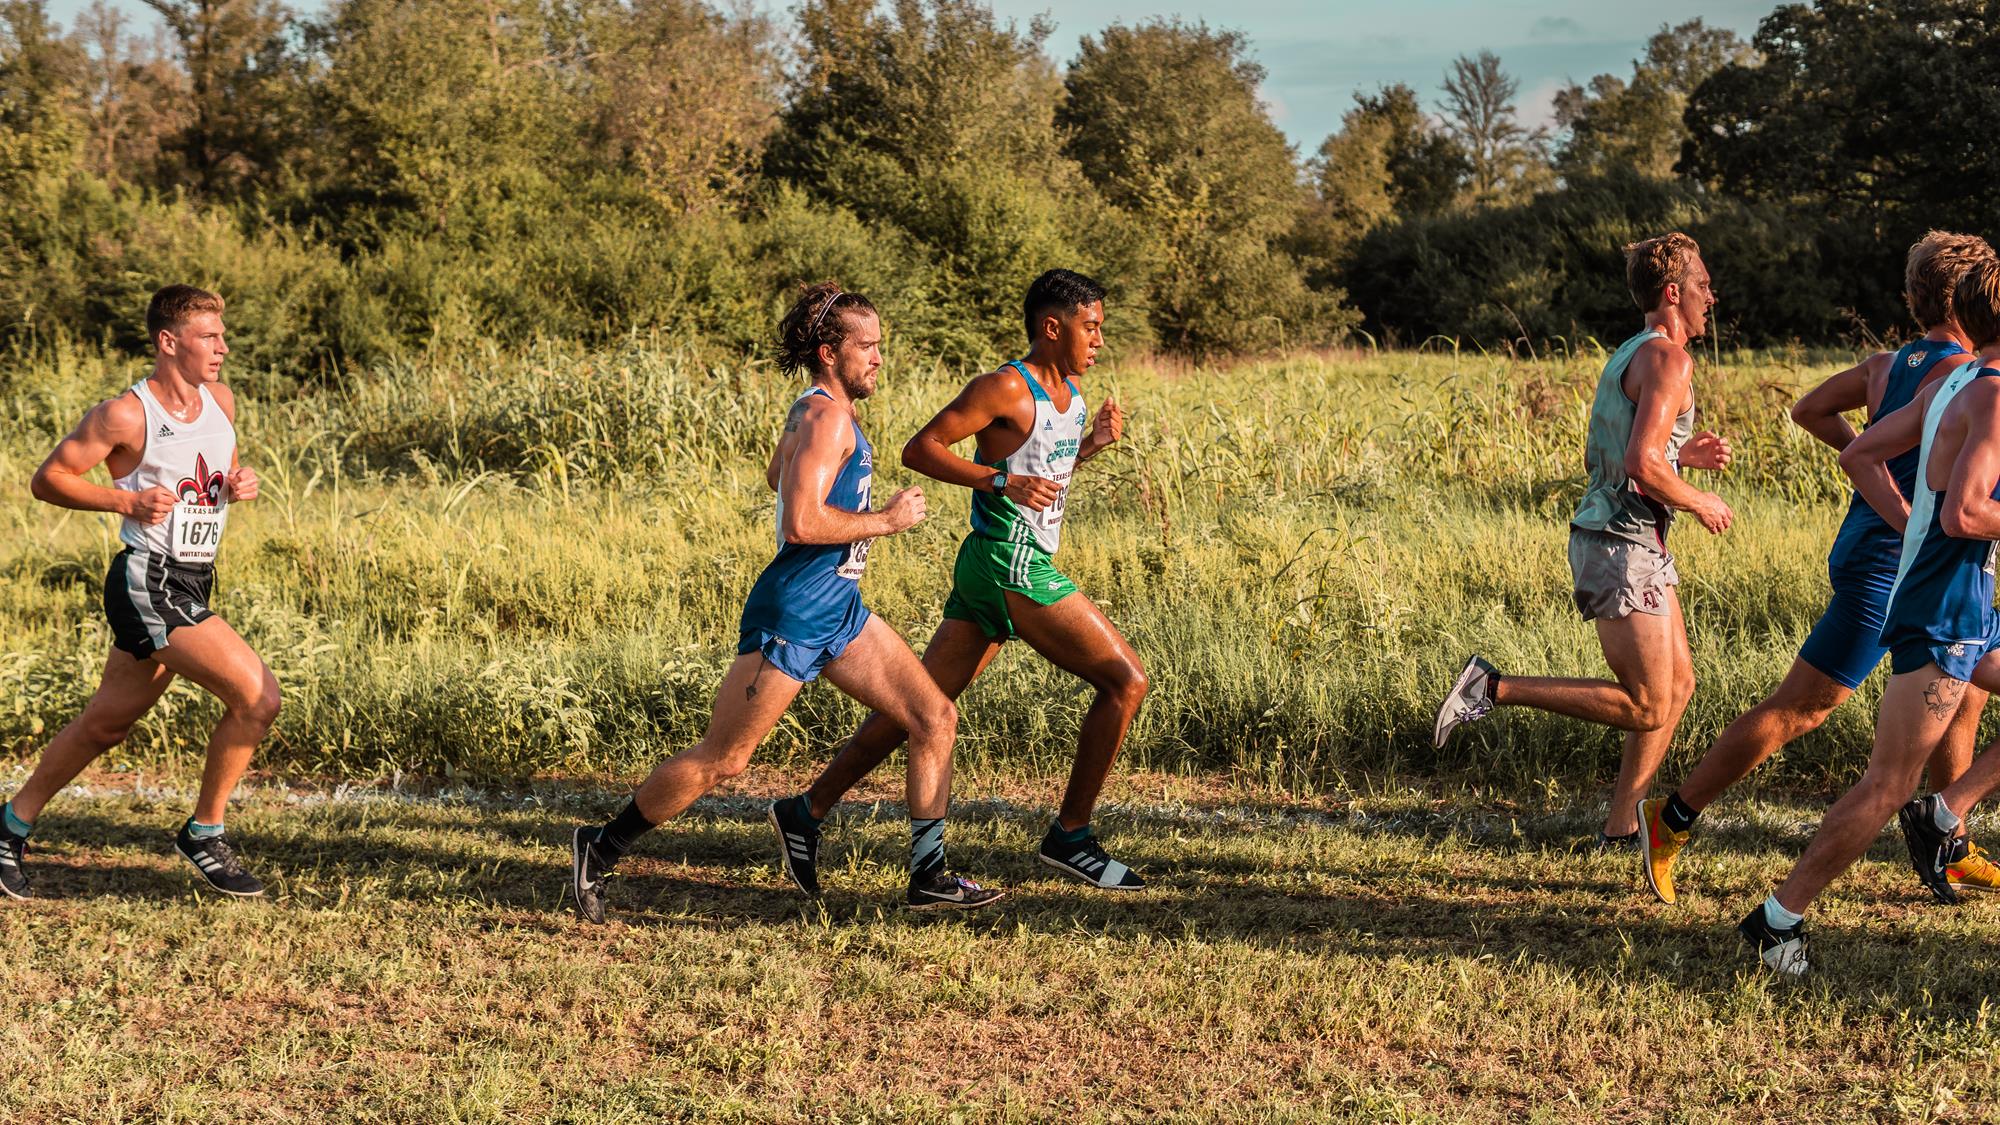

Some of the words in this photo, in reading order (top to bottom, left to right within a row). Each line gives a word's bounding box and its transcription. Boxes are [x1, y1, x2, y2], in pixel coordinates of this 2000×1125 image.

[1052, 471, 1068, 482] TEXAS
[183, 507, 207, 515] TEXAS
[181, 521, 219, 546] 1676
